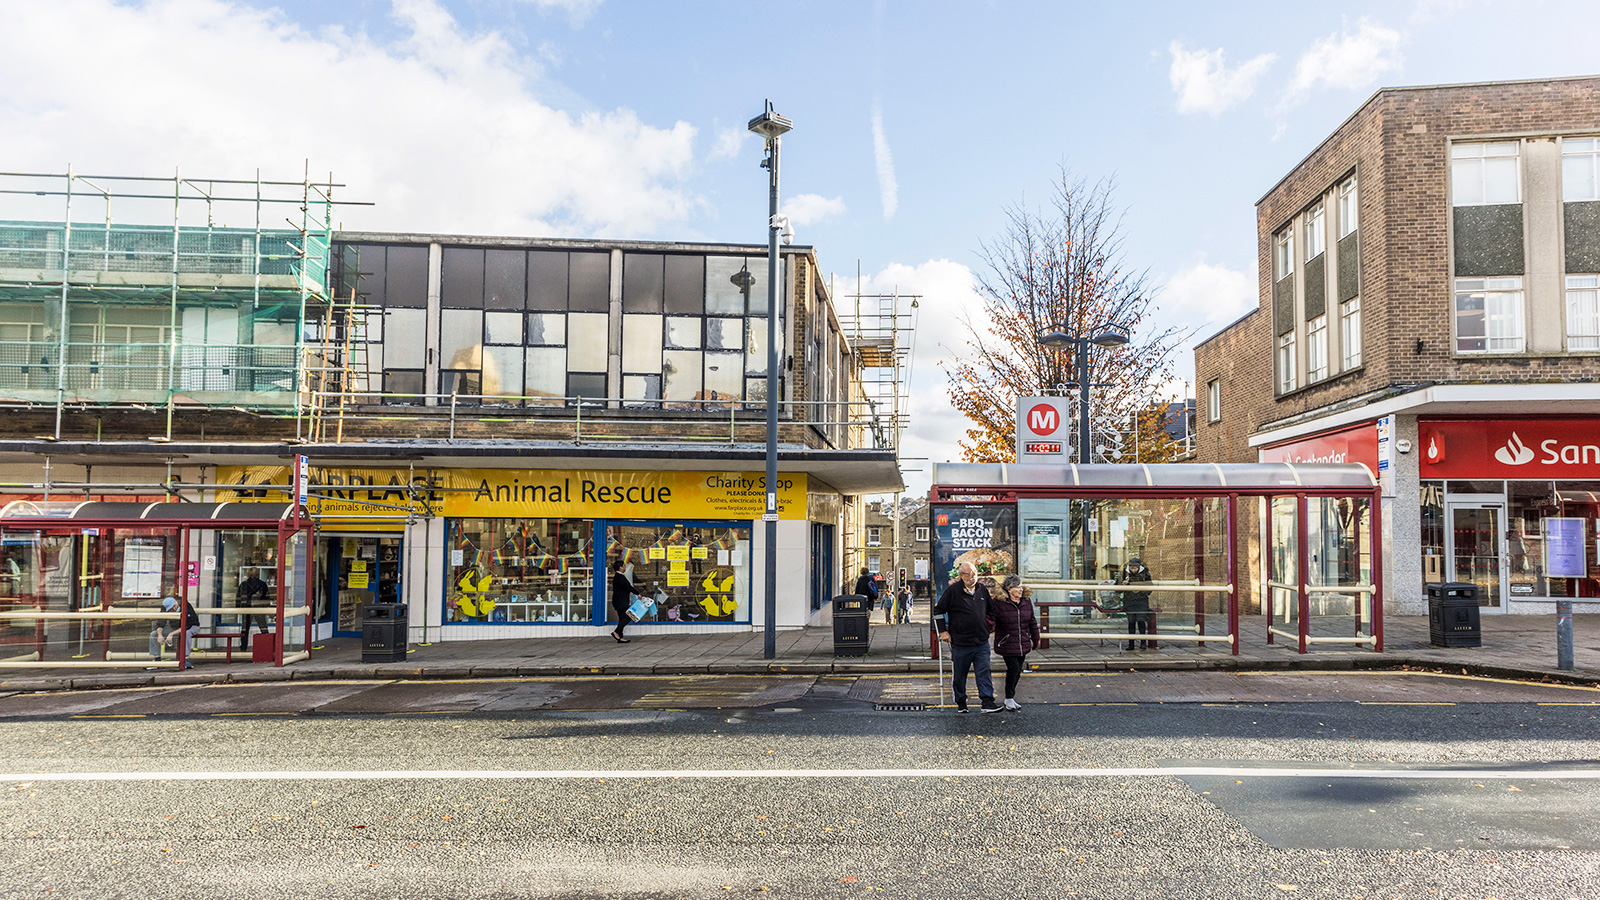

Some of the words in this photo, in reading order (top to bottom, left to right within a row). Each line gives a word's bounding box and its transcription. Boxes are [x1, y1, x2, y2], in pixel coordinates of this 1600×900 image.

[1031, 410, 1055, 429] M
[1540, 439, 1600, 465] San
[706, 475, 755, 491] Charity
[758, 476, 793, 491] Sop
[474, 478, 571, 503] Animal
[581, 479, 672, 504] Rescue
[705, 496, 729, 504] Clothes,
[324, 502, 359, 512] animals
[361, 502, 398, 514] rejected
[400, 503, 444, 513] elewere
[951, 528, 993, 538] BACON
[952, 538, 992, 548] STACK
